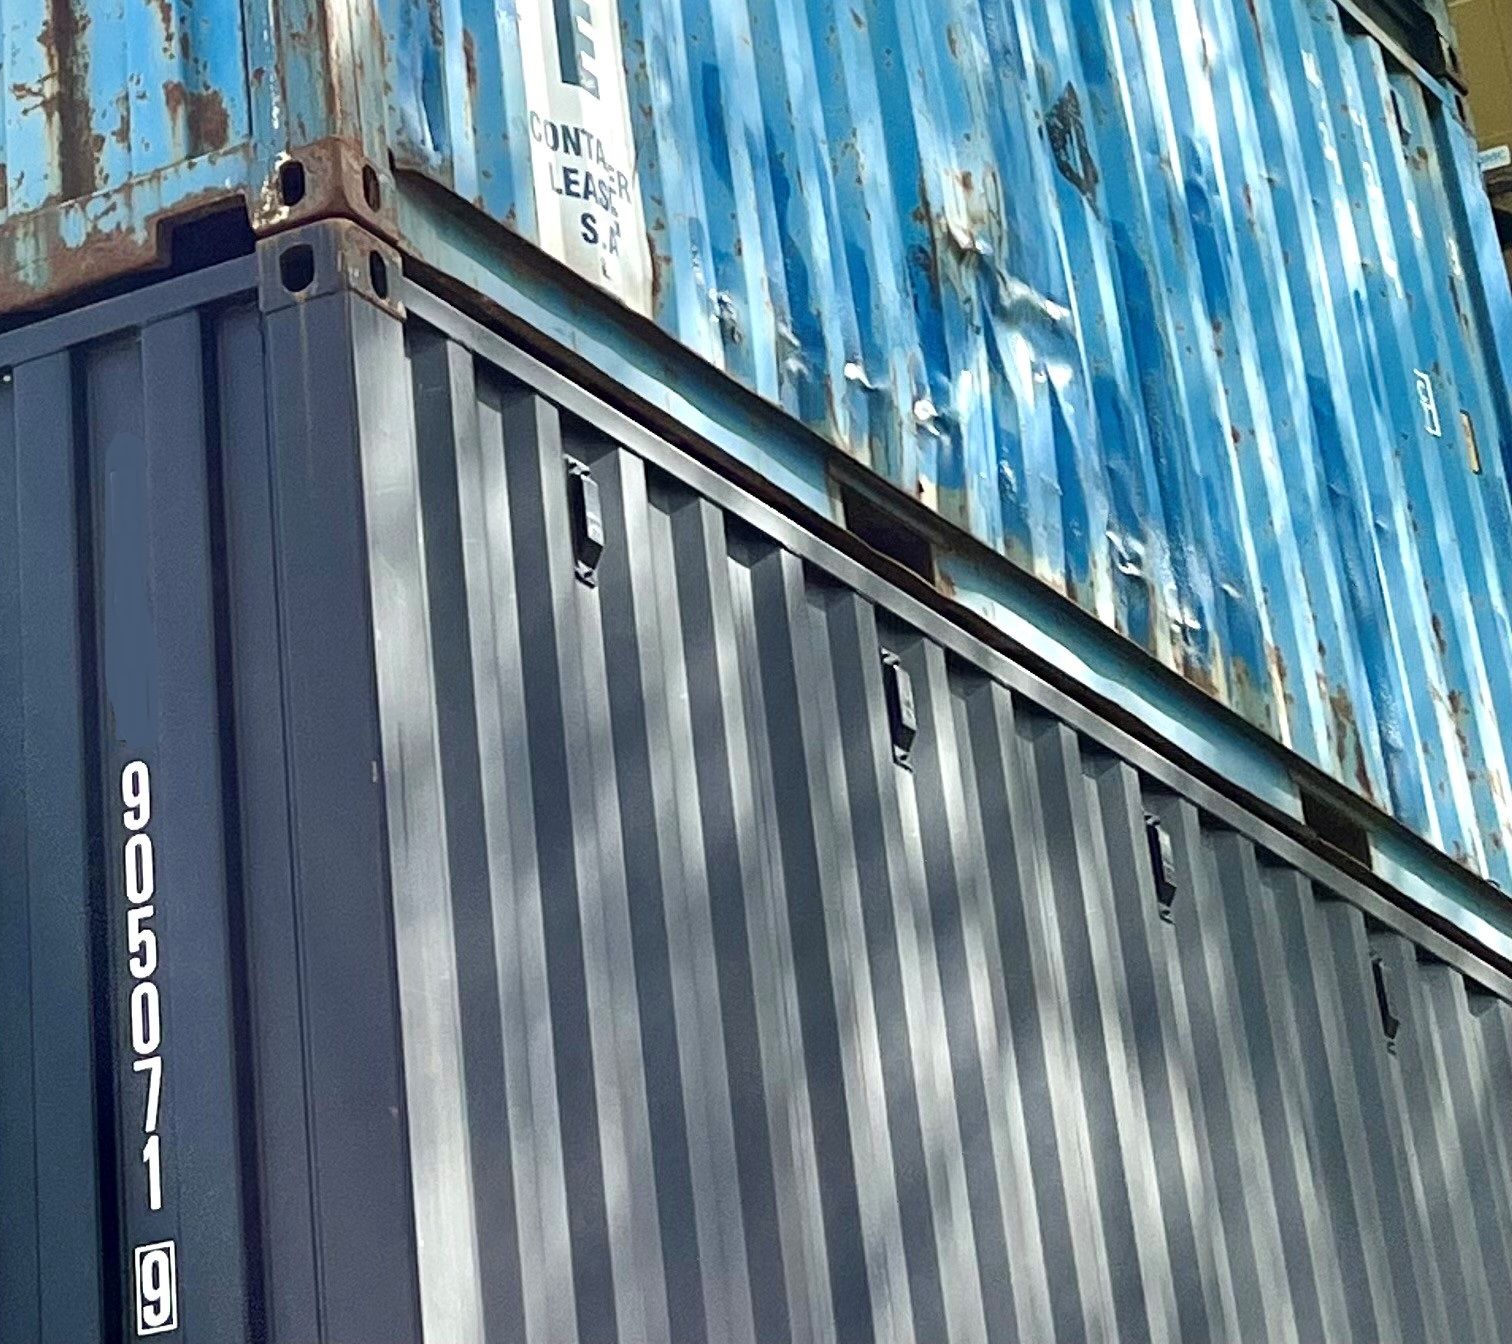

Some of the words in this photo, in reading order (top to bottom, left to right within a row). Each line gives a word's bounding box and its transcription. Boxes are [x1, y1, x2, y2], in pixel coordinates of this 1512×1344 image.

[529, 110, 632, 205] CONTAR
[120, 759, 164, 1212] 905071
[140, 1246, 175, 1330] 9
